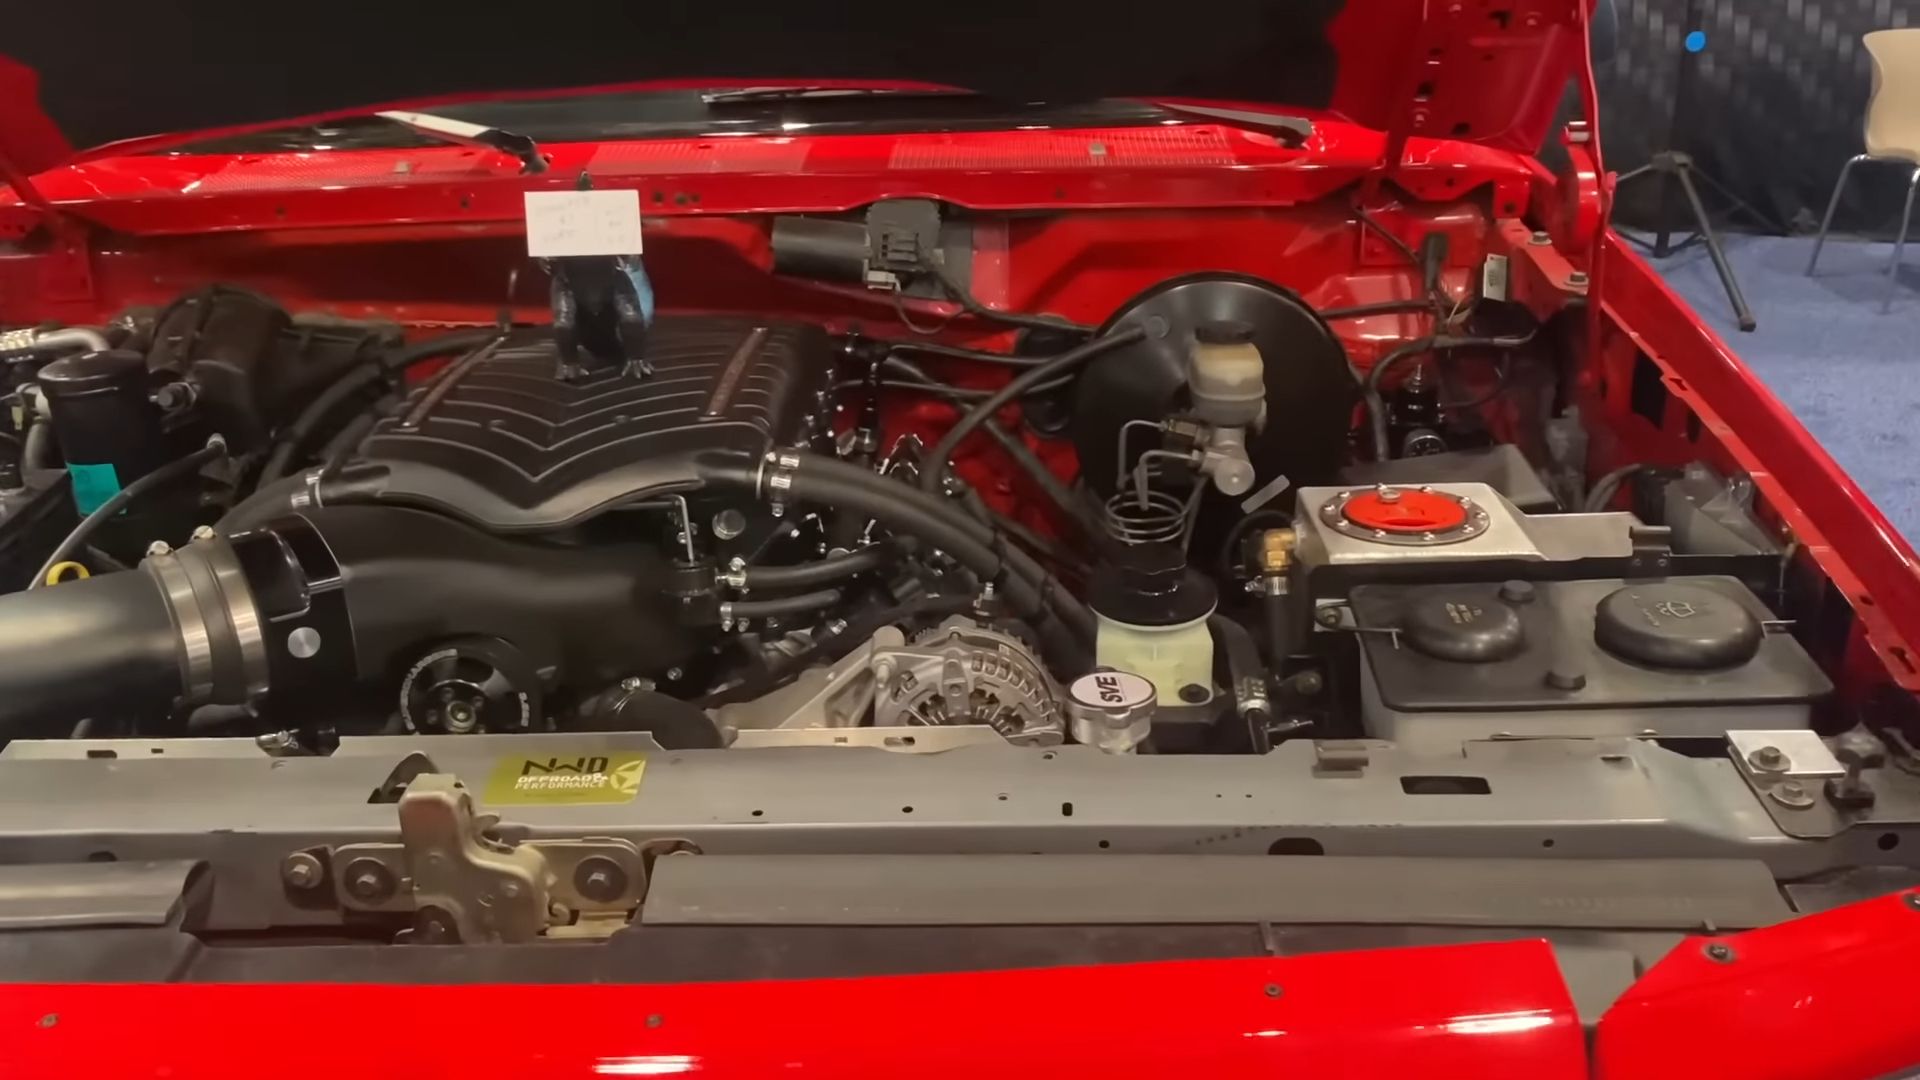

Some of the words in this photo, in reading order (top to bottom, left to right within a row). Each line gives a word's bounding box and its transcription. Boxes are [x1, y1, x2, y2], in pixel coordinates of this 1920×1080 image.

[1095, 676, 1123, 702] SVE
[521, 757, 609, 775] NWD
[514, 781, 606, 789] PERFORMANCE
[517, 774, 593, 783] OFFROAD
